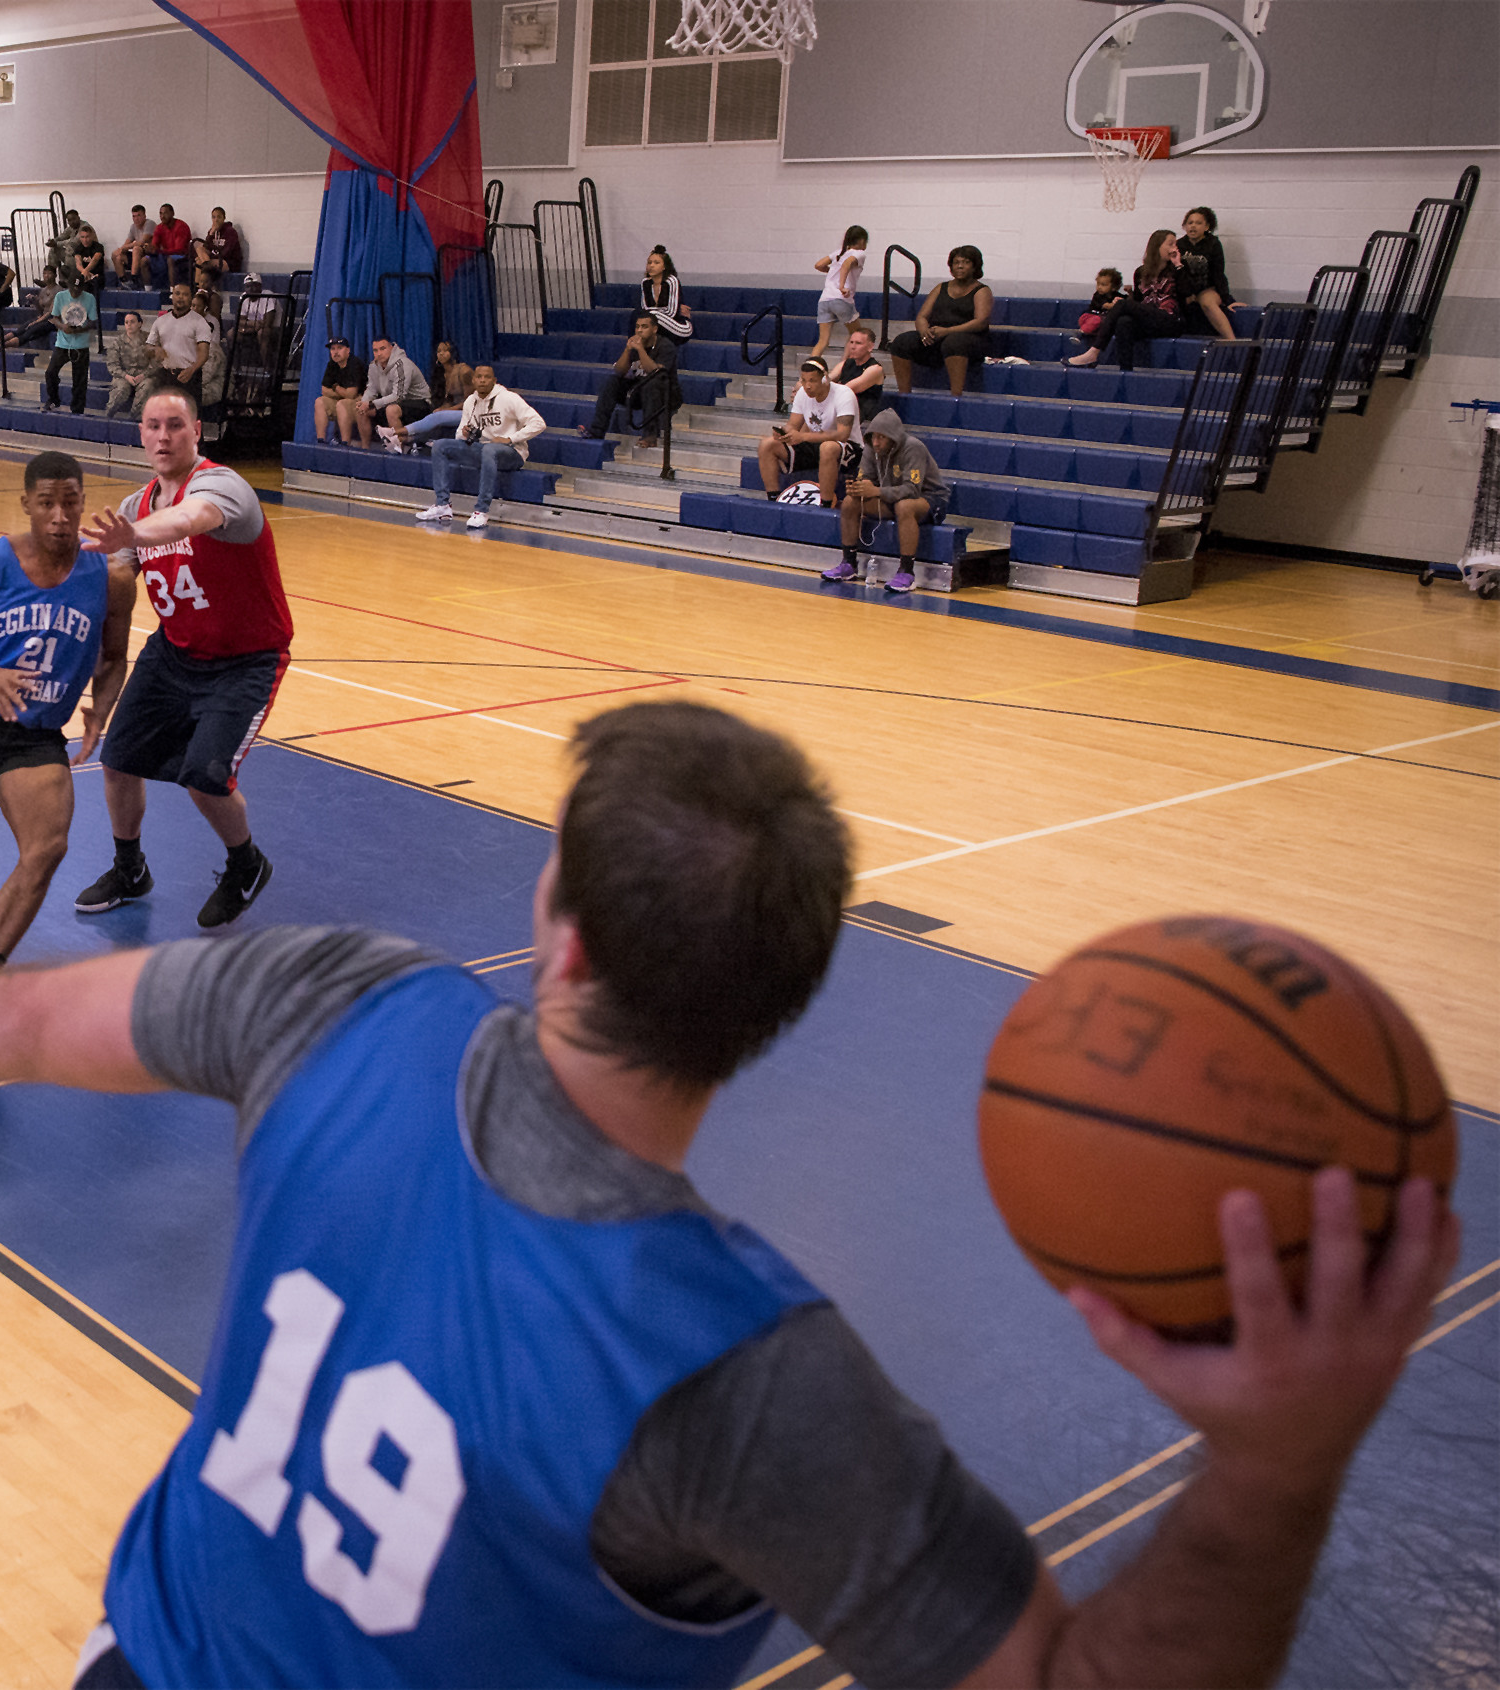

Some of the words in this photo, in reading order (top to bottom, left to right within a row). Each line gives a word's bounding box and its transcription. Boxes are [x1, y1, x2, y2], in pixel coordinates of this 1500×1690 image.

[474, 412, 502, 428] VANS
[145, 564, 211, 617] 34
[52, 604, 92, 643] AFB
[15, 636, 58, 673] 21
[200, 1267, 467, 1636] 19
